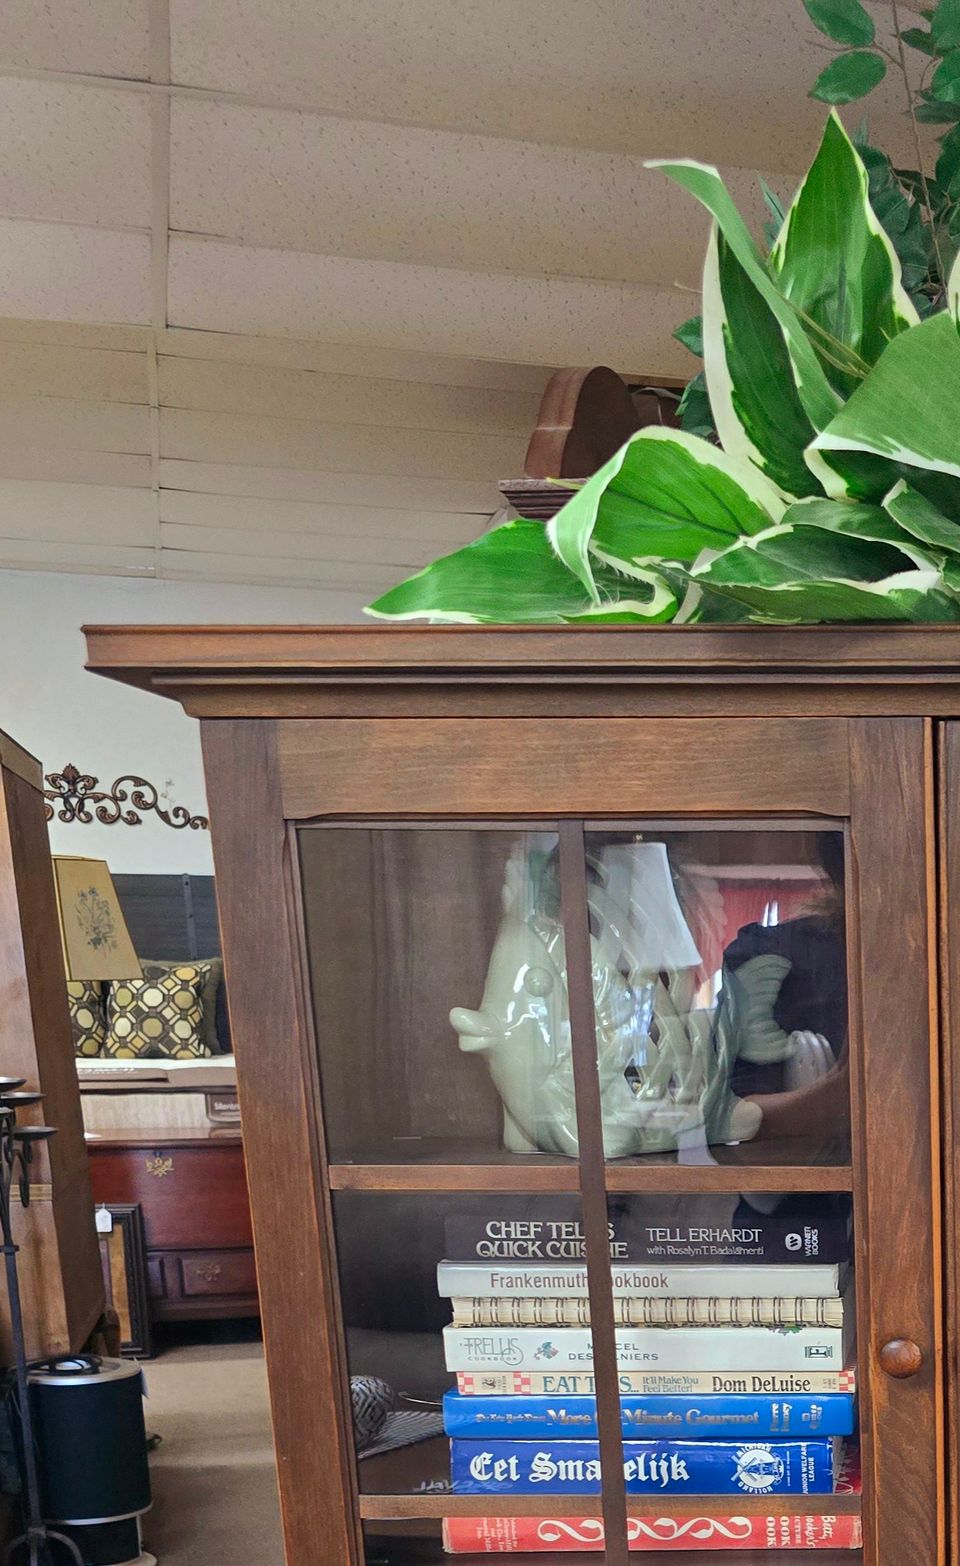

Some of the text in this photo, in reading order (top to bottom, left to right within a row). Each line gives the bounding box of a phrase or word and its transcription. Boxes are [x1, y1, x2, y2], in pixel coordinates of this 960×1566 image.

[485, 1220, 543, 1239] CHEF
[644, 1227, 763, 1243] TELL ERHARDT
[475, 1240, 545, 1258] QUICK
[803, 1225, 811, 1257] WARNER
[811, 1228, 819, 1256] BOOKS
[646, 1245, 666, 1255] with
[667, 1245, 701, 1257] Rosalyn
[490, 1272, 669, 1289] Frankenmuth okbook
[543, 1375, 580, 1393] EAT
[643, 1384, 662, 1393] Feel
[658, 1375, 681, 1385] Make
[682, 1375, 699, 1385] You
[712, 1375, 746, 1393] Dom
[751, 1375, 811, 1392] DeLuise
[545, 1408, 593, 1427] More
[685, 1407, 760, 1426] Gourmet
[528, 1451, 690, 1488] Smaelijk
[807, 1456, 815, 1482] LEAGUE
[801, 1472, 809, 1495] JUNIOR
[766, 1515, 777, 1548] OOK
[780, 1515, 791, 1547] OOK
[794, 1515, 802, 1545] ICTURE
